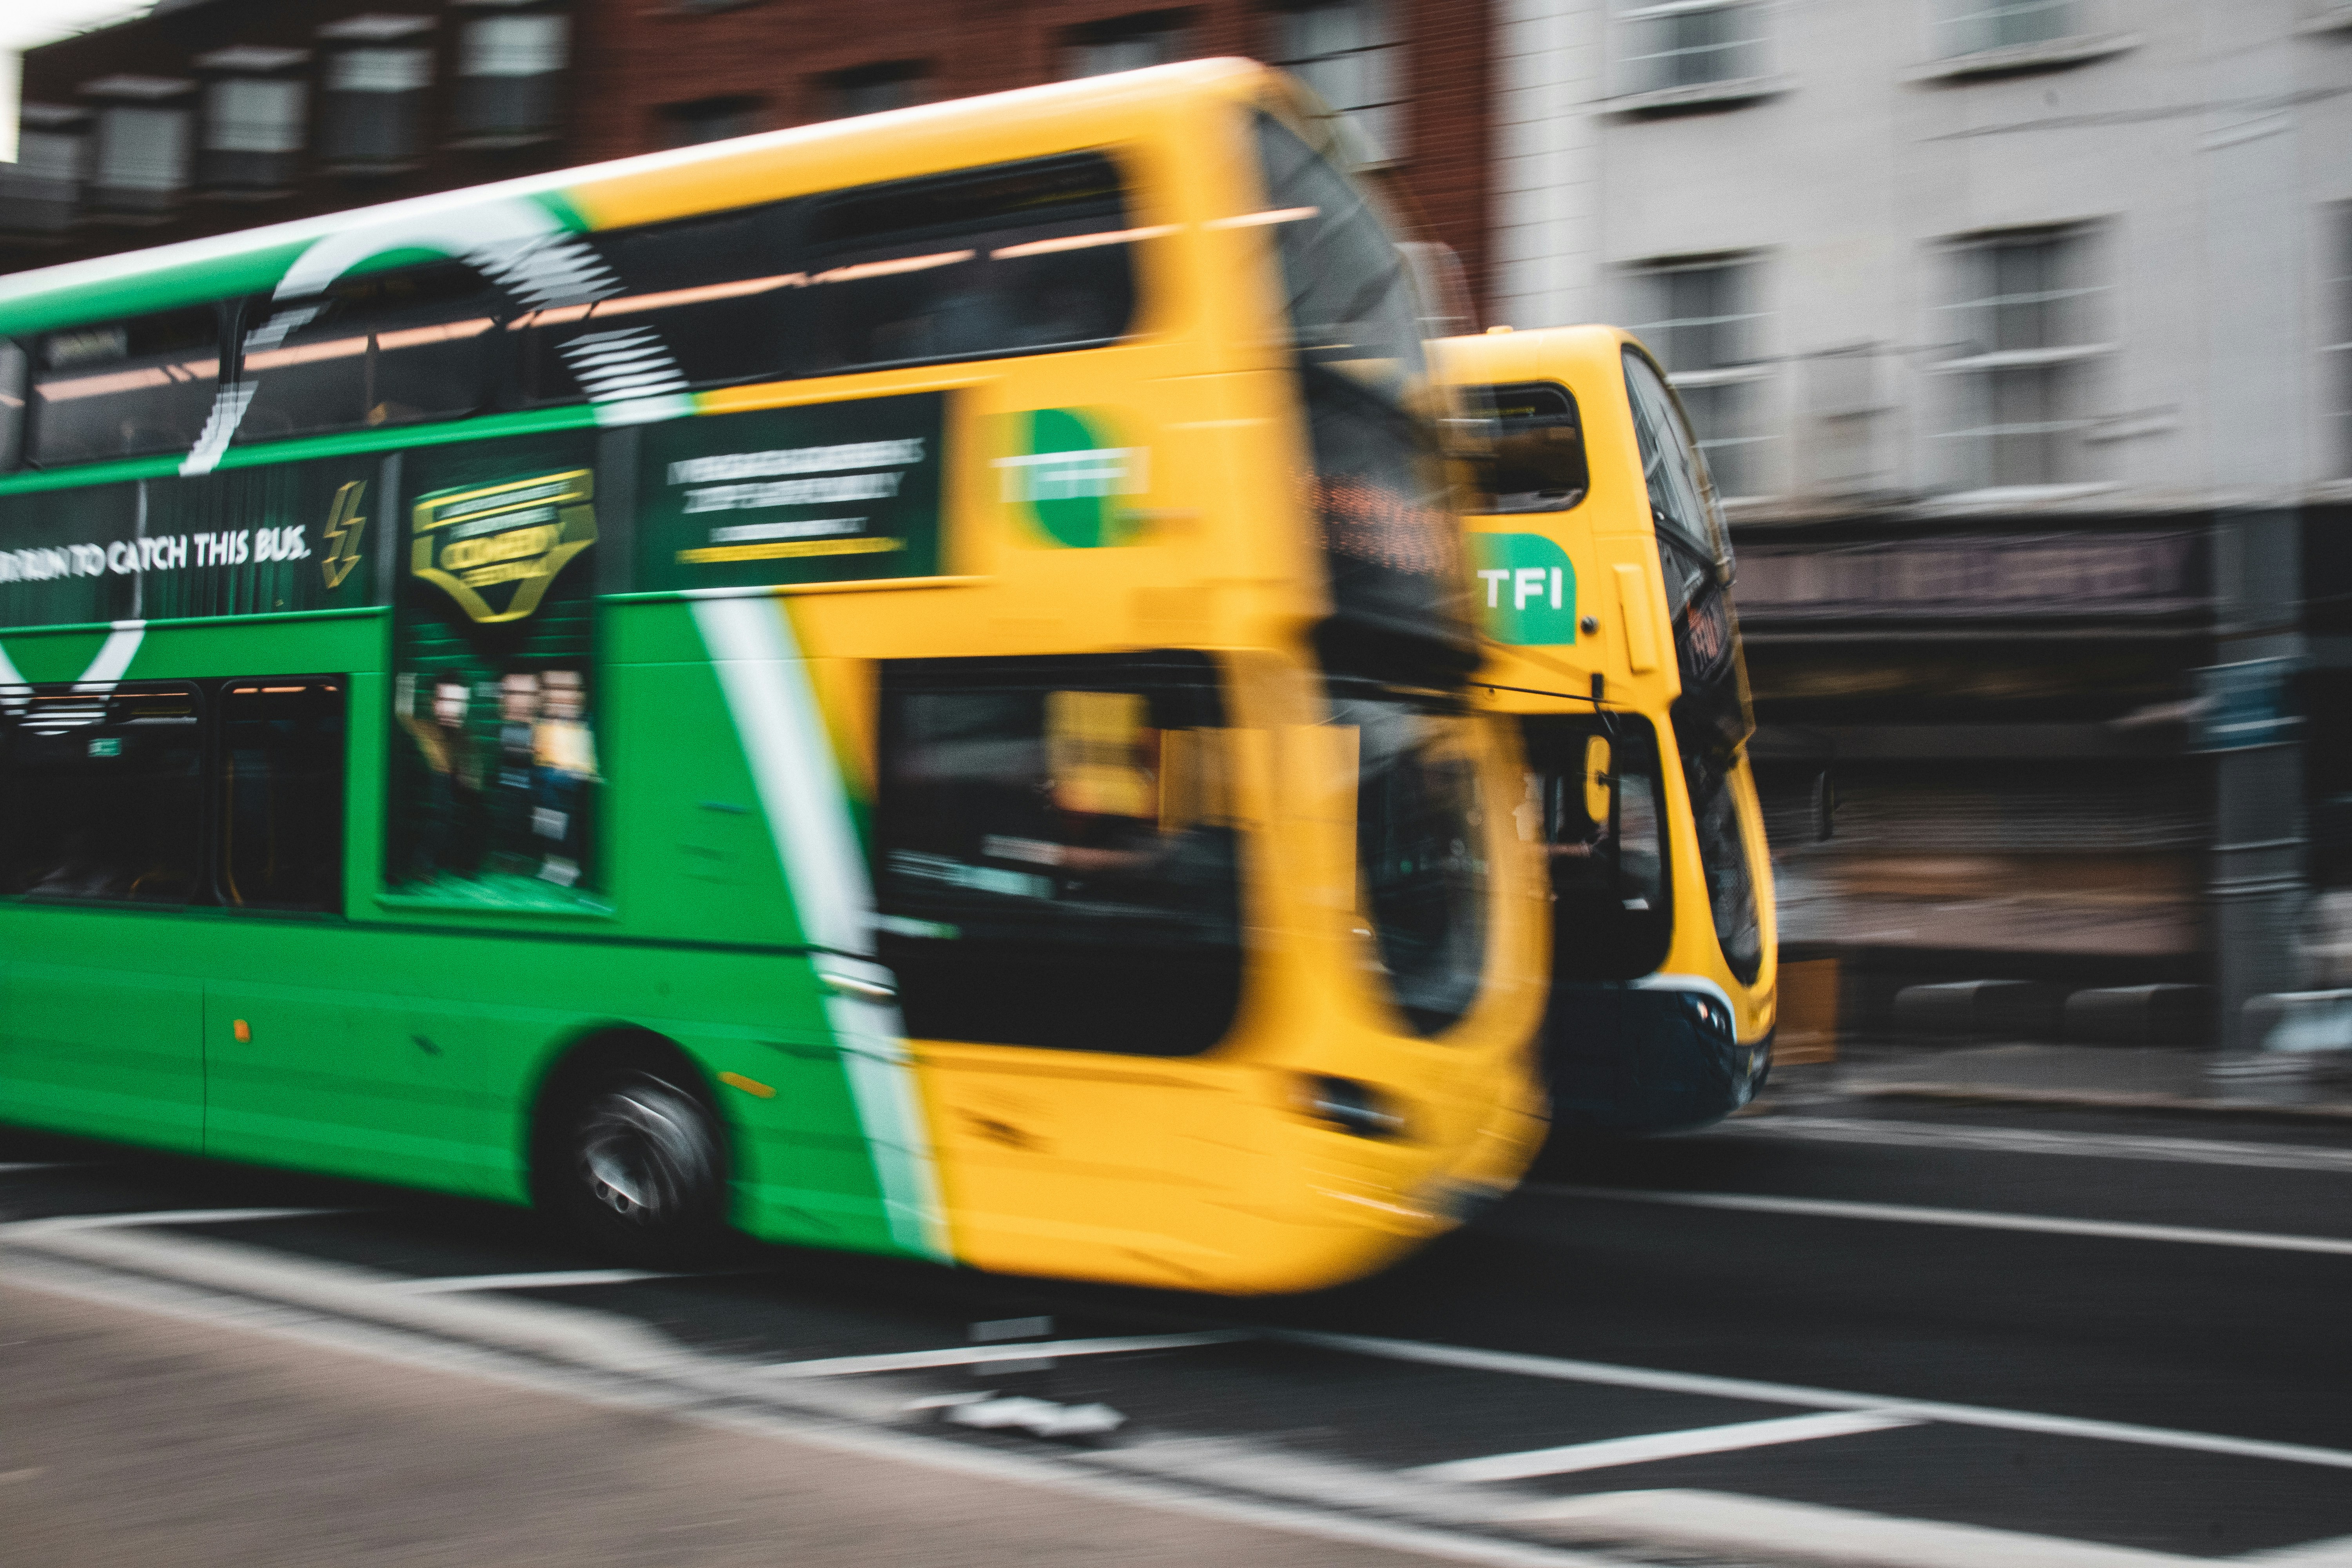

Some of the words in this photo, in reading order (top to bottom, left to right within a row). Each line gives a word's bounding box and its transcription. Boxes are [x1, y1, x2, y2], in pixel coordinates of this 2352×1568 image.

[107, 534, 187, 574] CATCH
[194, 529, 249, 567] THIS
[254, 524, 311, 563] BUS.
[1477, 567, 1562, 610] TFI
